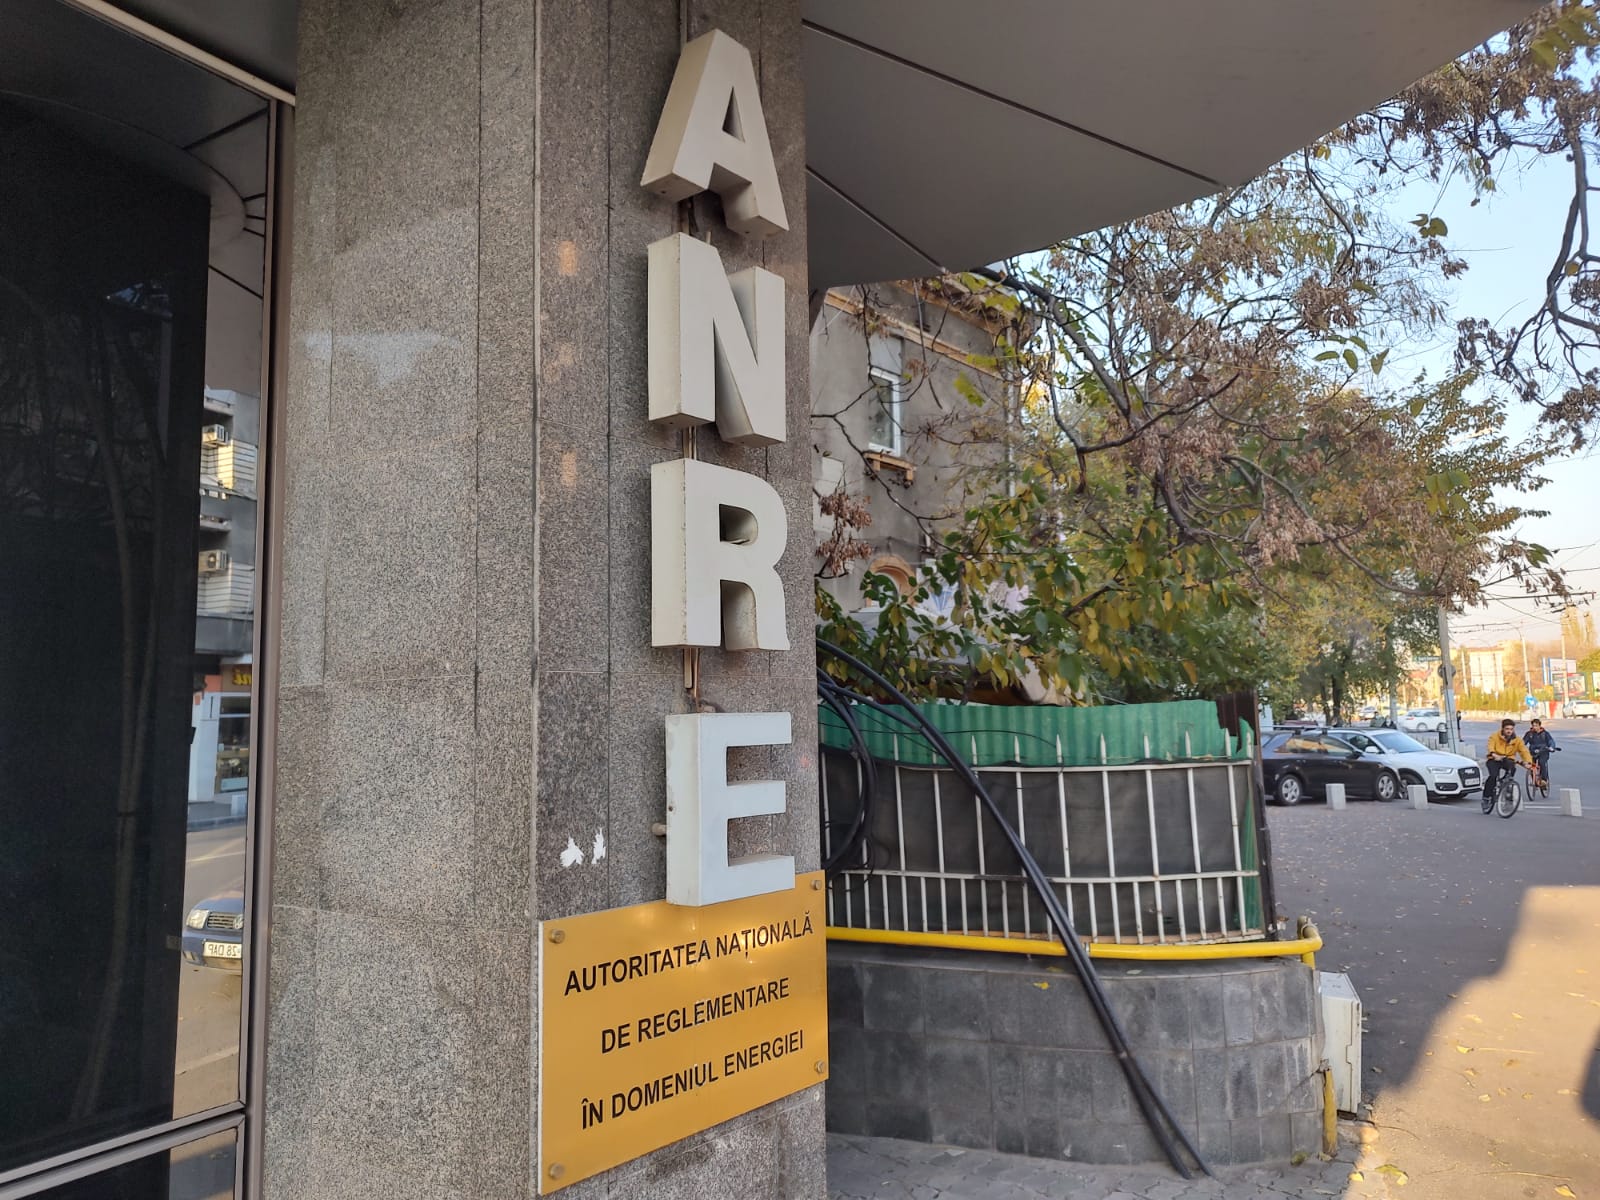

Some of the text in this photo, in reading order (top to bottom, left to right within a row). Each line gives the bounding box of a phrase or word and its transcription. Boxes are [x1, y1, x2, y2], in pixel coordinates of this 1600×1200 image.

[640, 28, 795, 907] ANRE
[564, 911, 813, 996] AUTORITATEA NAȚIONALĂ
[601, 977, 790, 1054] DE REGLEMENTARE
[581, 1029, 804, 1130] ÎN DOMENIUL ENERGIEI
